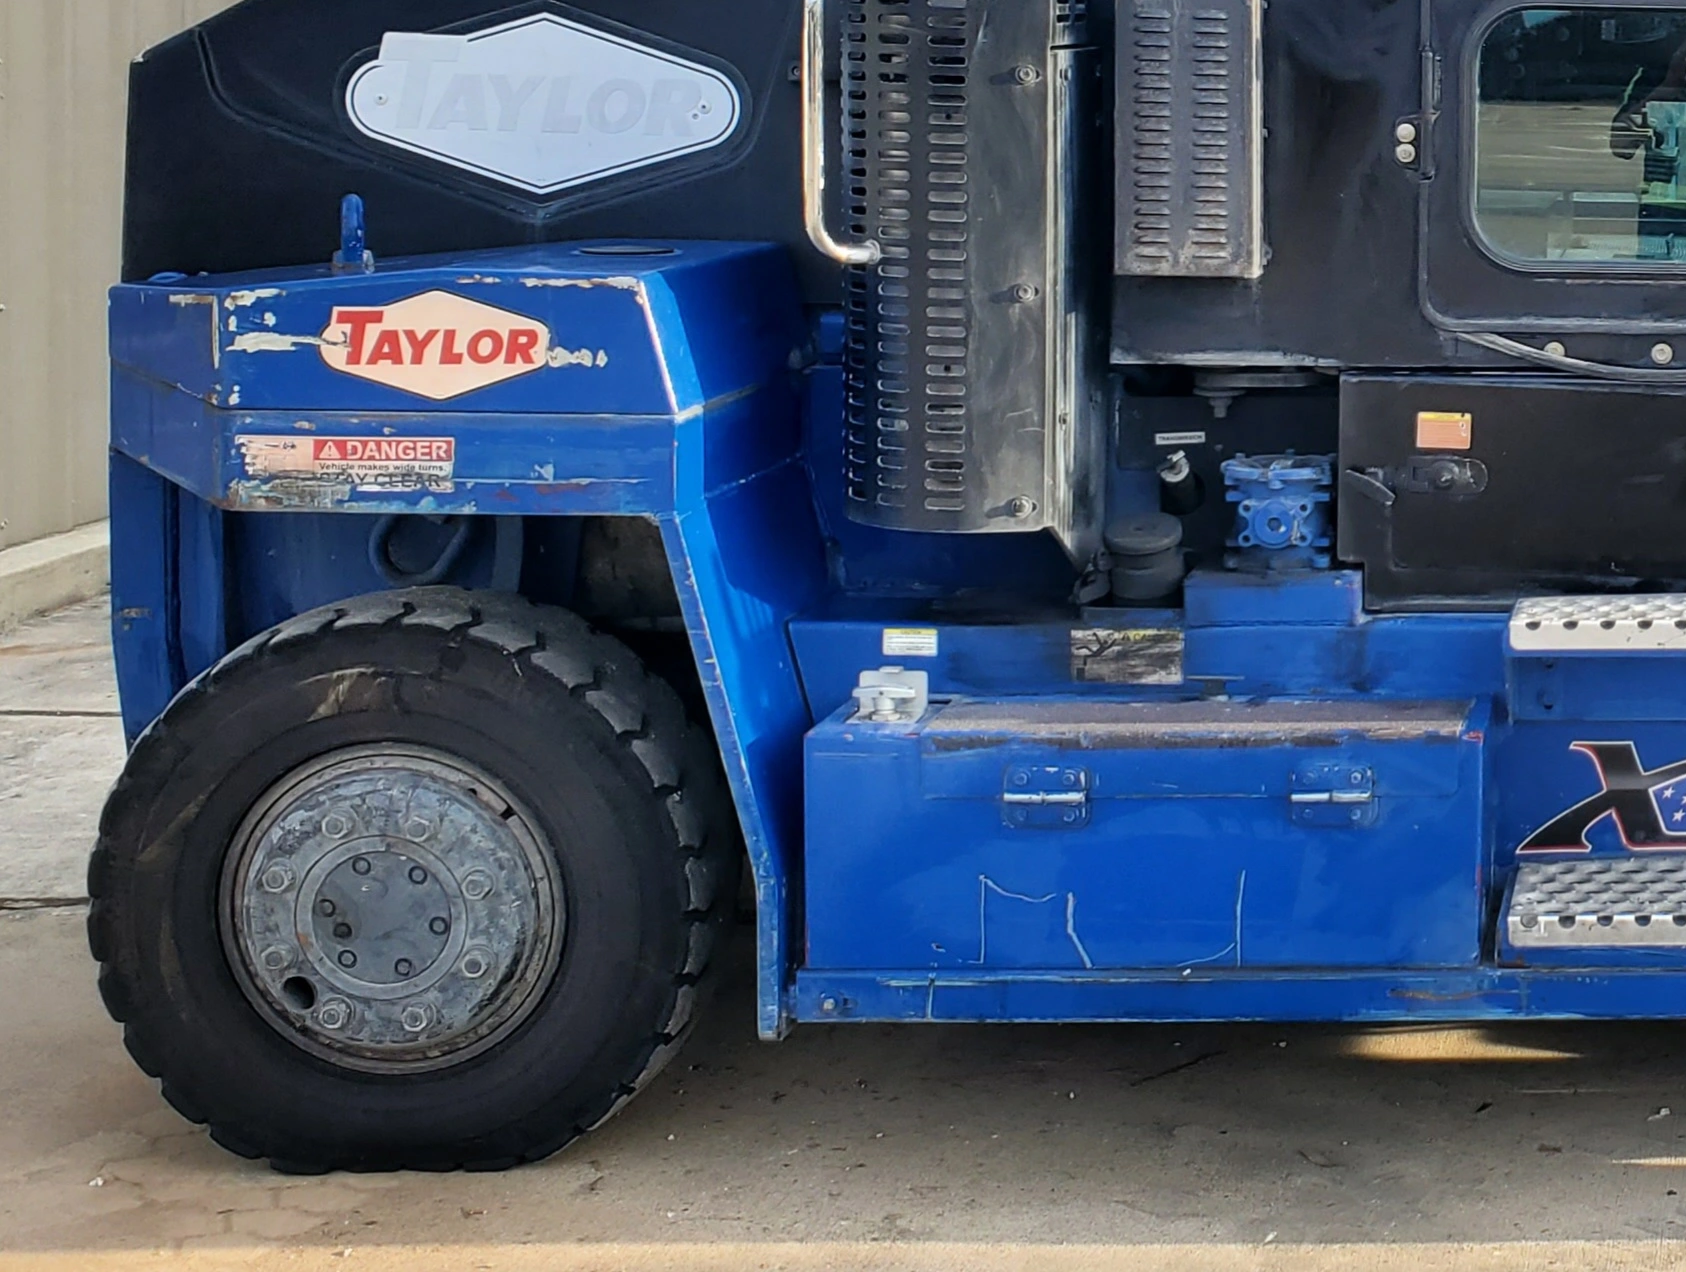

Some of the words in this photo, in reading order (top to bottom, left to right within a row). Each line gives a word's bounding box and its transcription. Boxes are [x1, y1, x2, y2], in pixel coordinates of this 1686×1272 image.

[381, 33, 703, 138] TAYLOR
[336, 310, 540, 365] TAYLOR
[319, 462, 355, 472] Vehicle
[357, 462, 389, 472] makes
[392, 463, 415, 472] wide
[418, 463, 448, 472] turns.
[346, 441, 449, 460] DANGER
